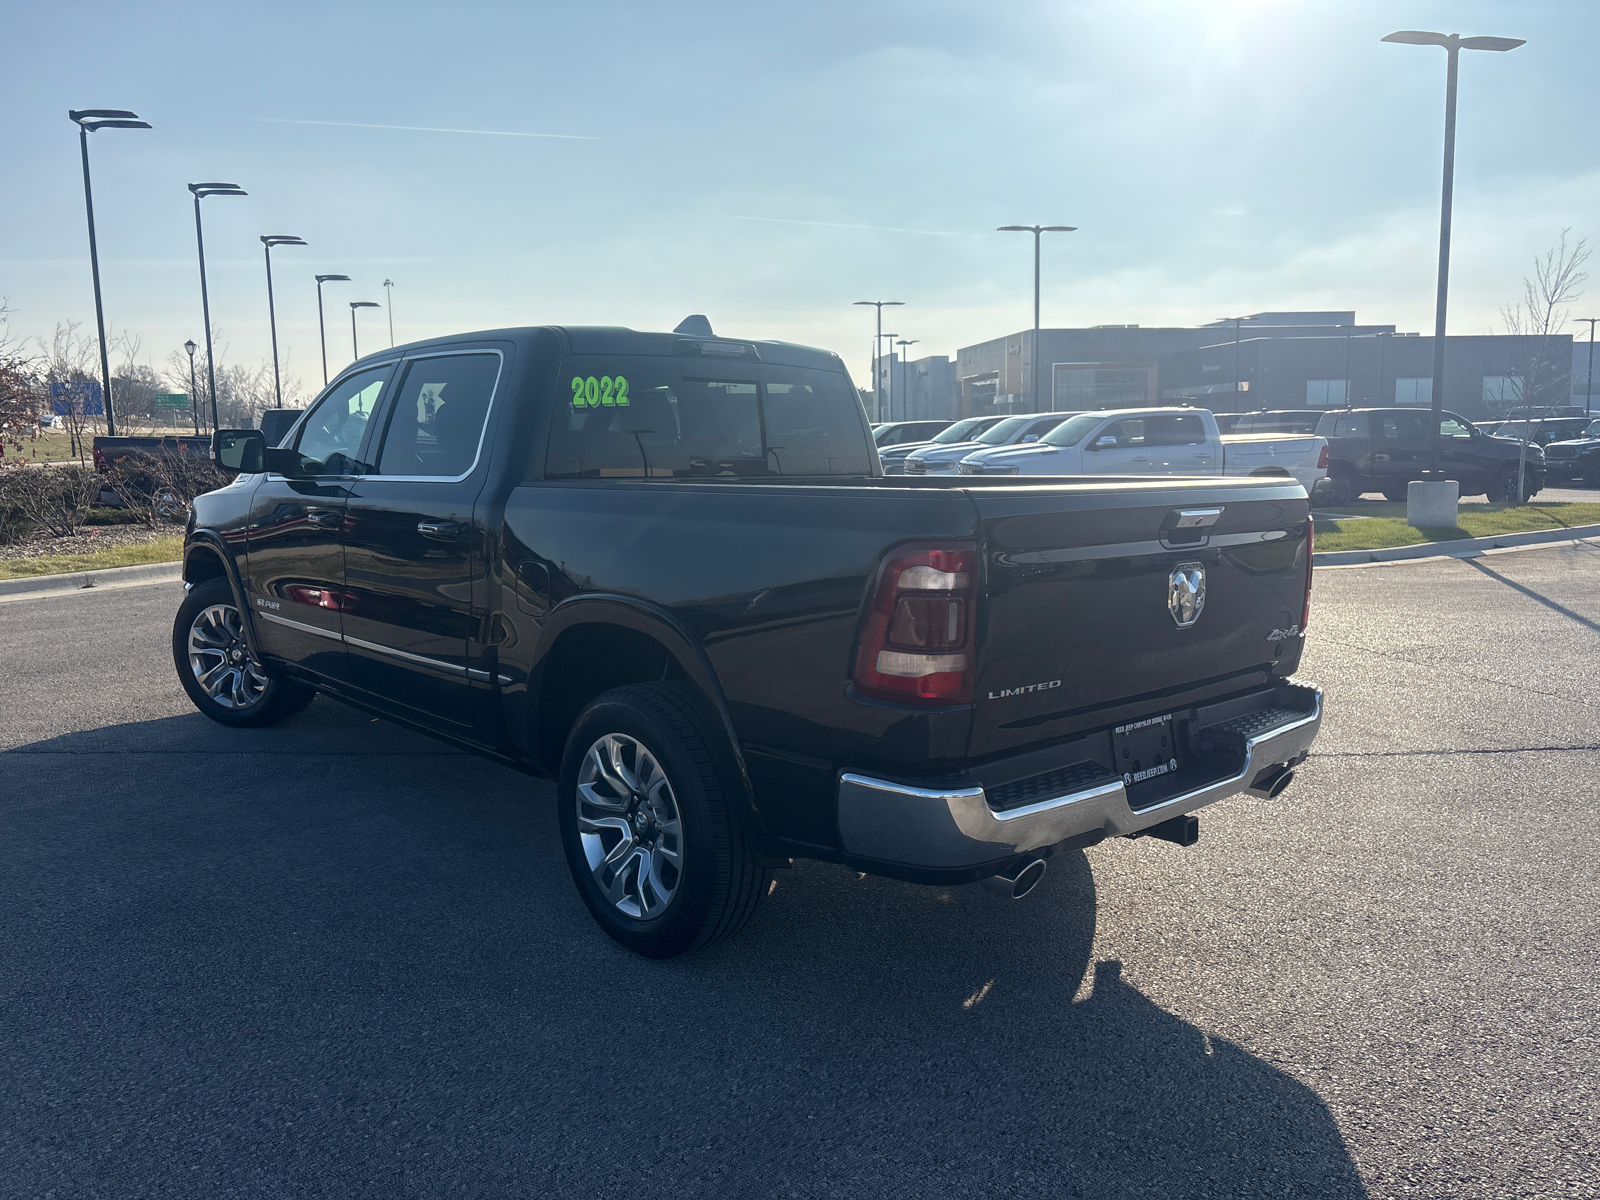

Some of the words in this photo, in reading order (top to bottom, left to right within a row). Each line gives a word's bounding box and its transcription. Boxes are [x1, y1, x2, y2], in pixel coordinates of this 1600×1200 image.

[571, 375, 630, 409] 2022
[257, 598, 280, 611] RAM
[988, 680, 1062, 700] LIMITED
[1115, 726, 1124, 734] REED
[1125, 723, 1133, 732] JEEP
[1134, 719, 1151, 729] CHRYSLER
[1152, 716, 1163, 724] DODGE
[1163, 713, 1172, 721] RAM
[1133, 764, 1168, 782] REEDJEEP.COM
